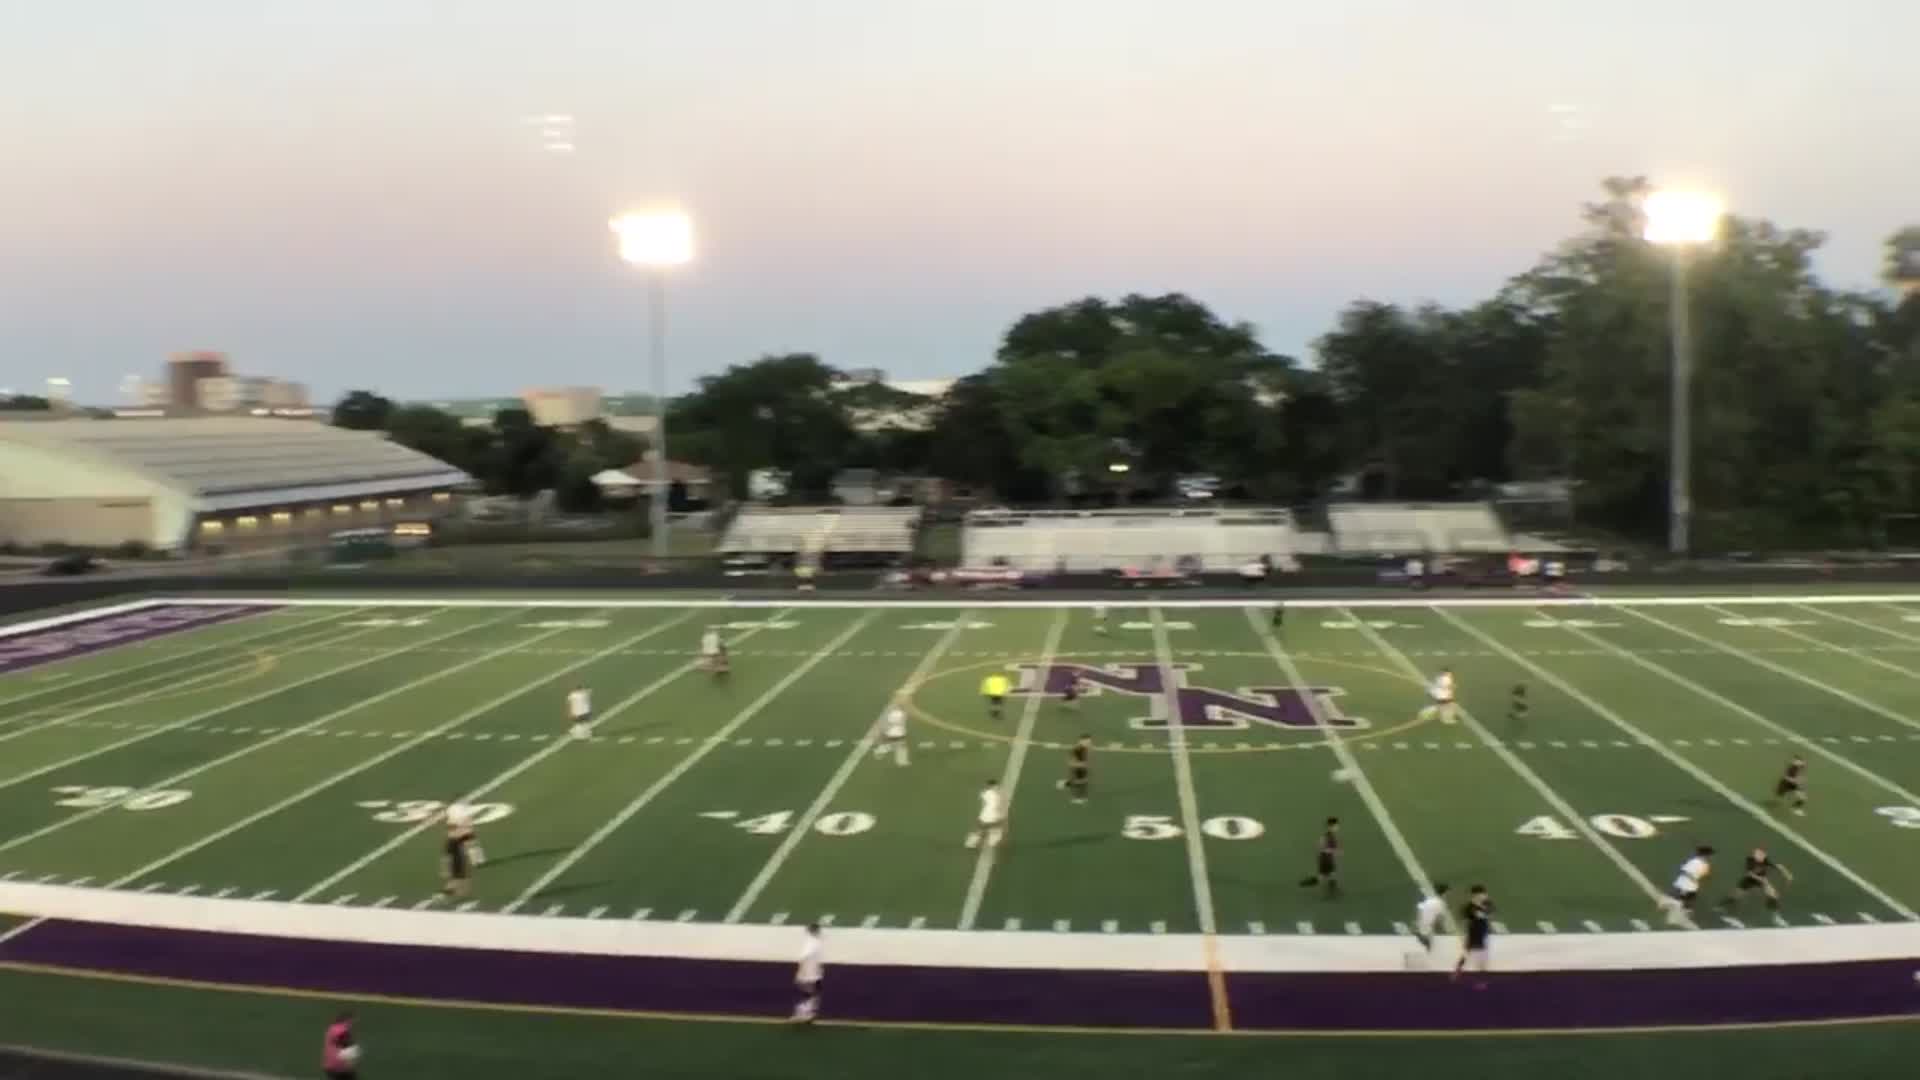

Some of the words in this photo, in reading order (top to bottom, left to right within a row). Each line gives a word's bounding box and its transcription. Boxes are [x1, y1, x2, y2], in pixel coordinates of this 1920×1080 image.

[734, 810, 877, 835] 40
[1121, 815, 1265, 840] 50
[1514, 814, 1658, 839] 40
